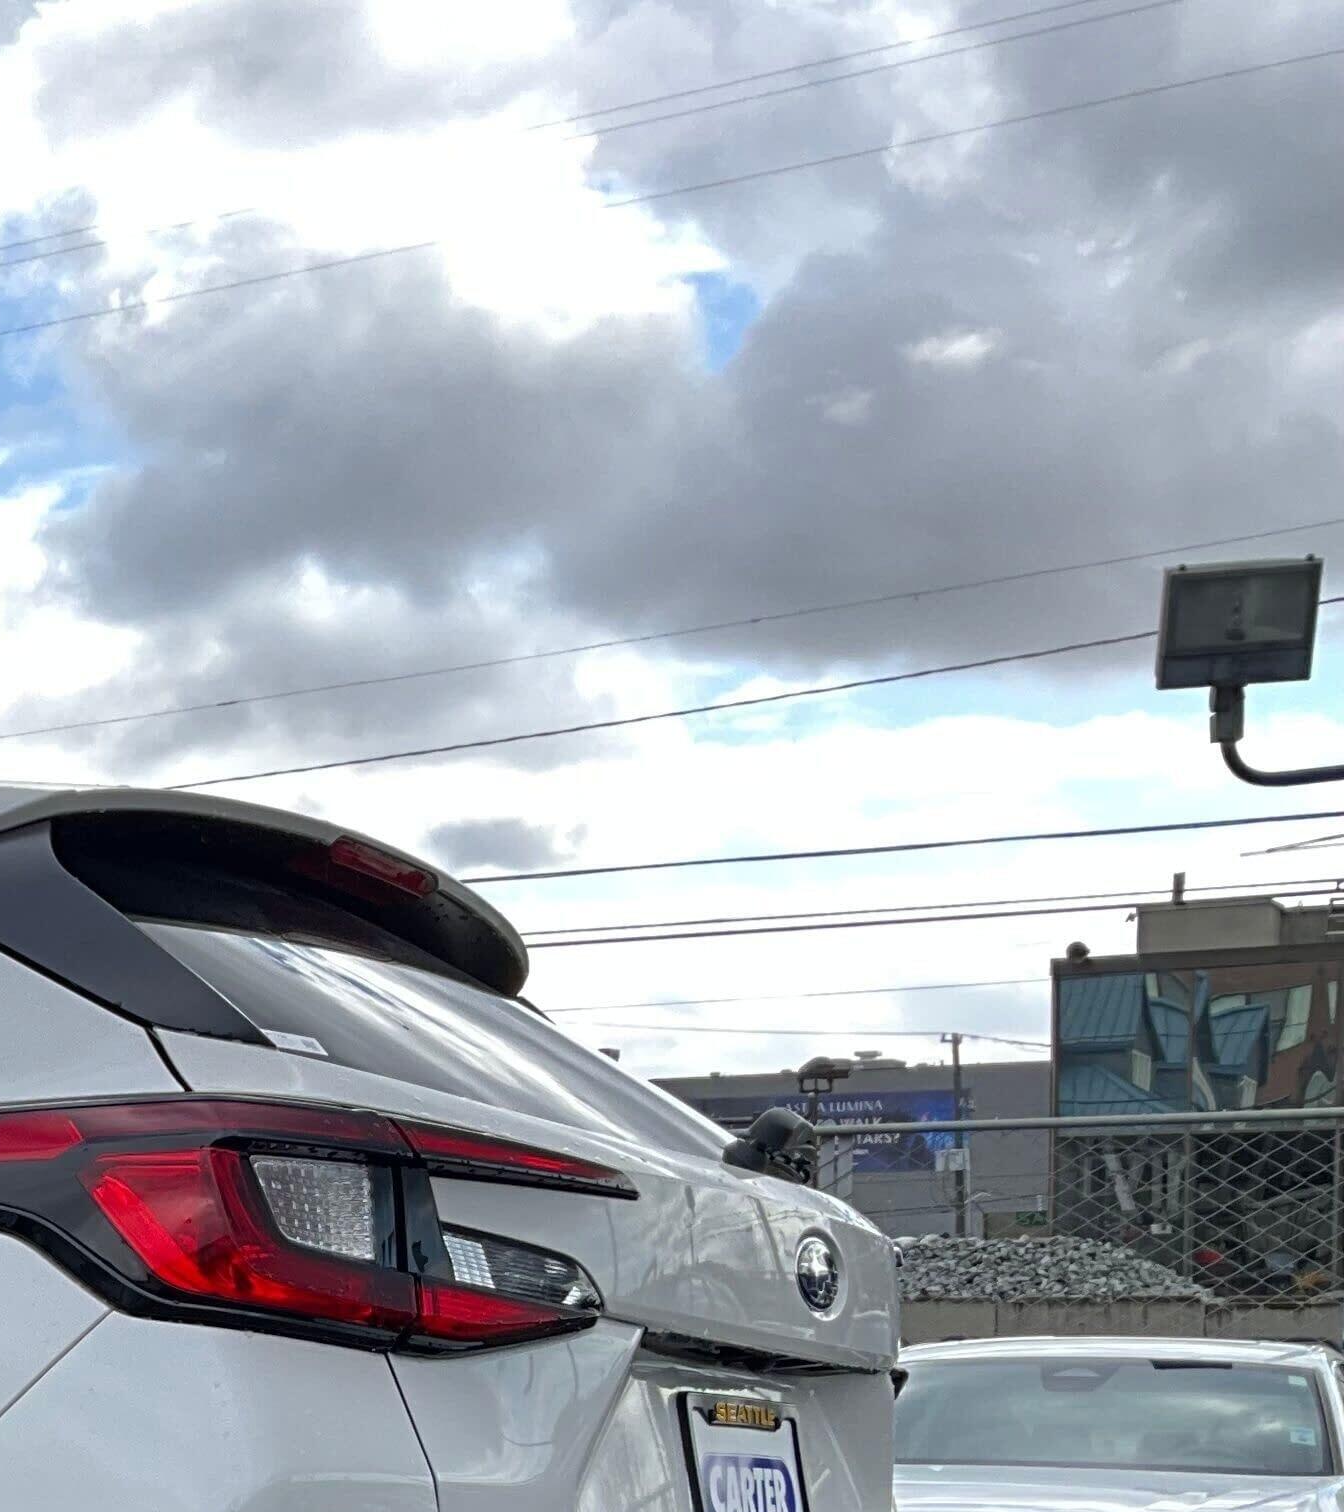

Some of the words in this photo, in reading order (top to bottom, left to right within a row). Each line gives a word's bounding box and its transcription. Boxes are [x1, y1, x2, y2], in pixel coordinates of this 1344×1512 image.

[785, 1101, 826, 1114] ASTA
[829, 1100, 883, 1113] LUMINA
[852, 1132, 901, 1145] TARS?
[714, 1402, 777, 1426] SEATTLE
